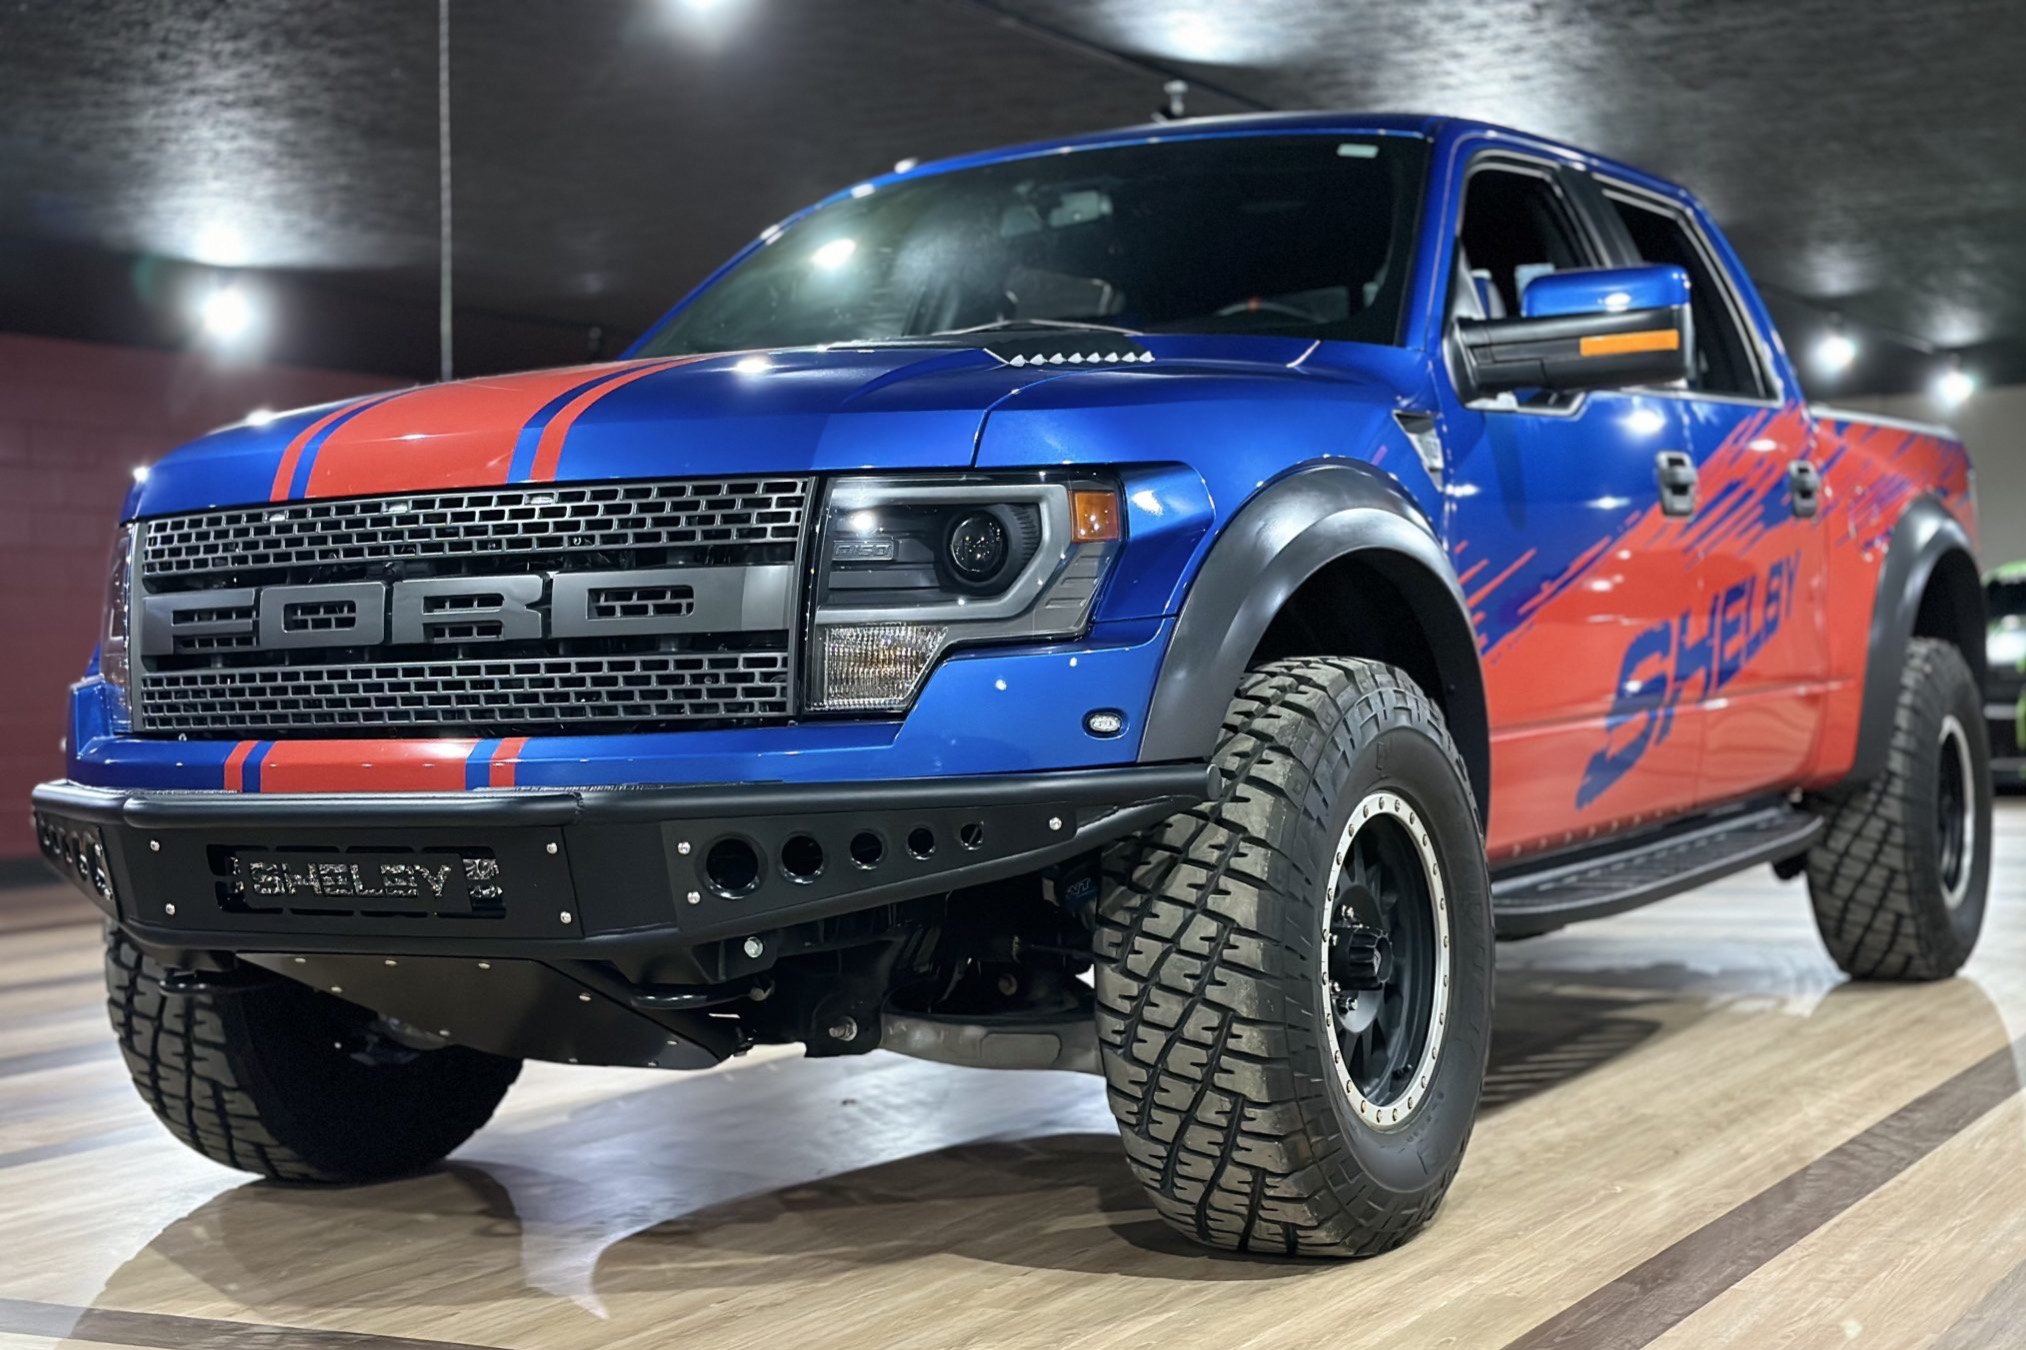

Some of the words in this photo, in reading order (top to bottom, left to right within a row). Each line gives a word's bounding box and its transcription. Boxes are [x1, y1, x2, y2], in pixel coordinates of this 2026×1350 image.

[142, 567, 765, 655] FORD
[1575, 549, 1802, 811] SHELBY
[250, 861, 451, 897] SHELBY
